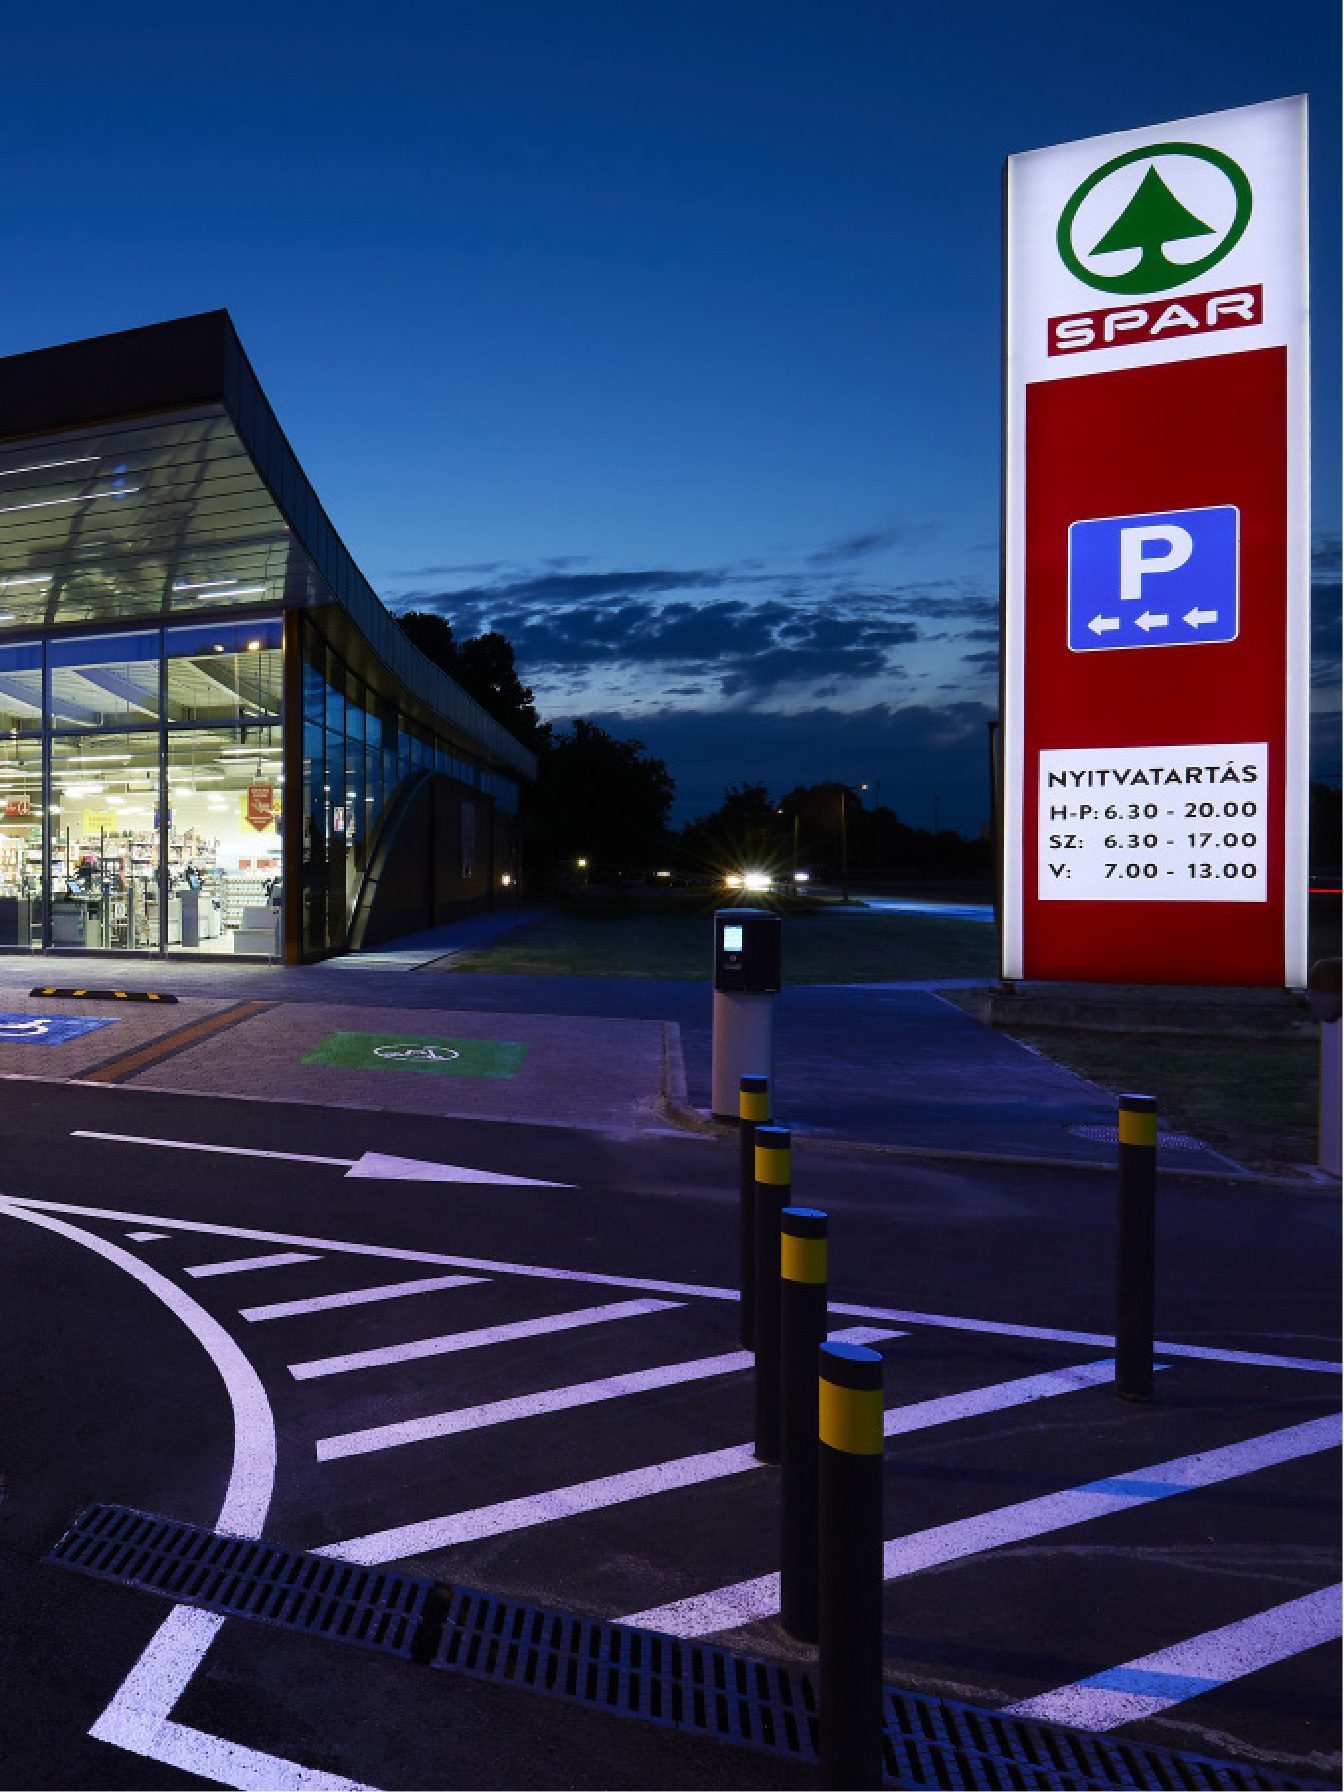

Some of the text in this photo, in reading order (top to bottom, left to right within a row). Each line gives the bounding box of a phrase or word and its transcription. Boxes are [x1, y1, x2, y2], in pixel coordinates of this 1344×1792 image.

[1056, 293, 1255, 349] SPAR
[1120, 525, 1193, 600] P
[1048, 761, 1258, 787] NYITVATARTÁS
[1050, 805, 1098, 821] H-P:
[1104, 804, 1158, 820] 6.30
[1184, 801, 1257, 818] 20.00
[1049, 834, 1084, 849] SZ:
[1104, 834, 1158, 849] 6.30
[1187, 832, 1257, 849] 17.00
[1048, 863, 1072, 879] V:
[1104, 863, 1158, 879] 7.00
[1187, 863, 1257, 879] 13.00
